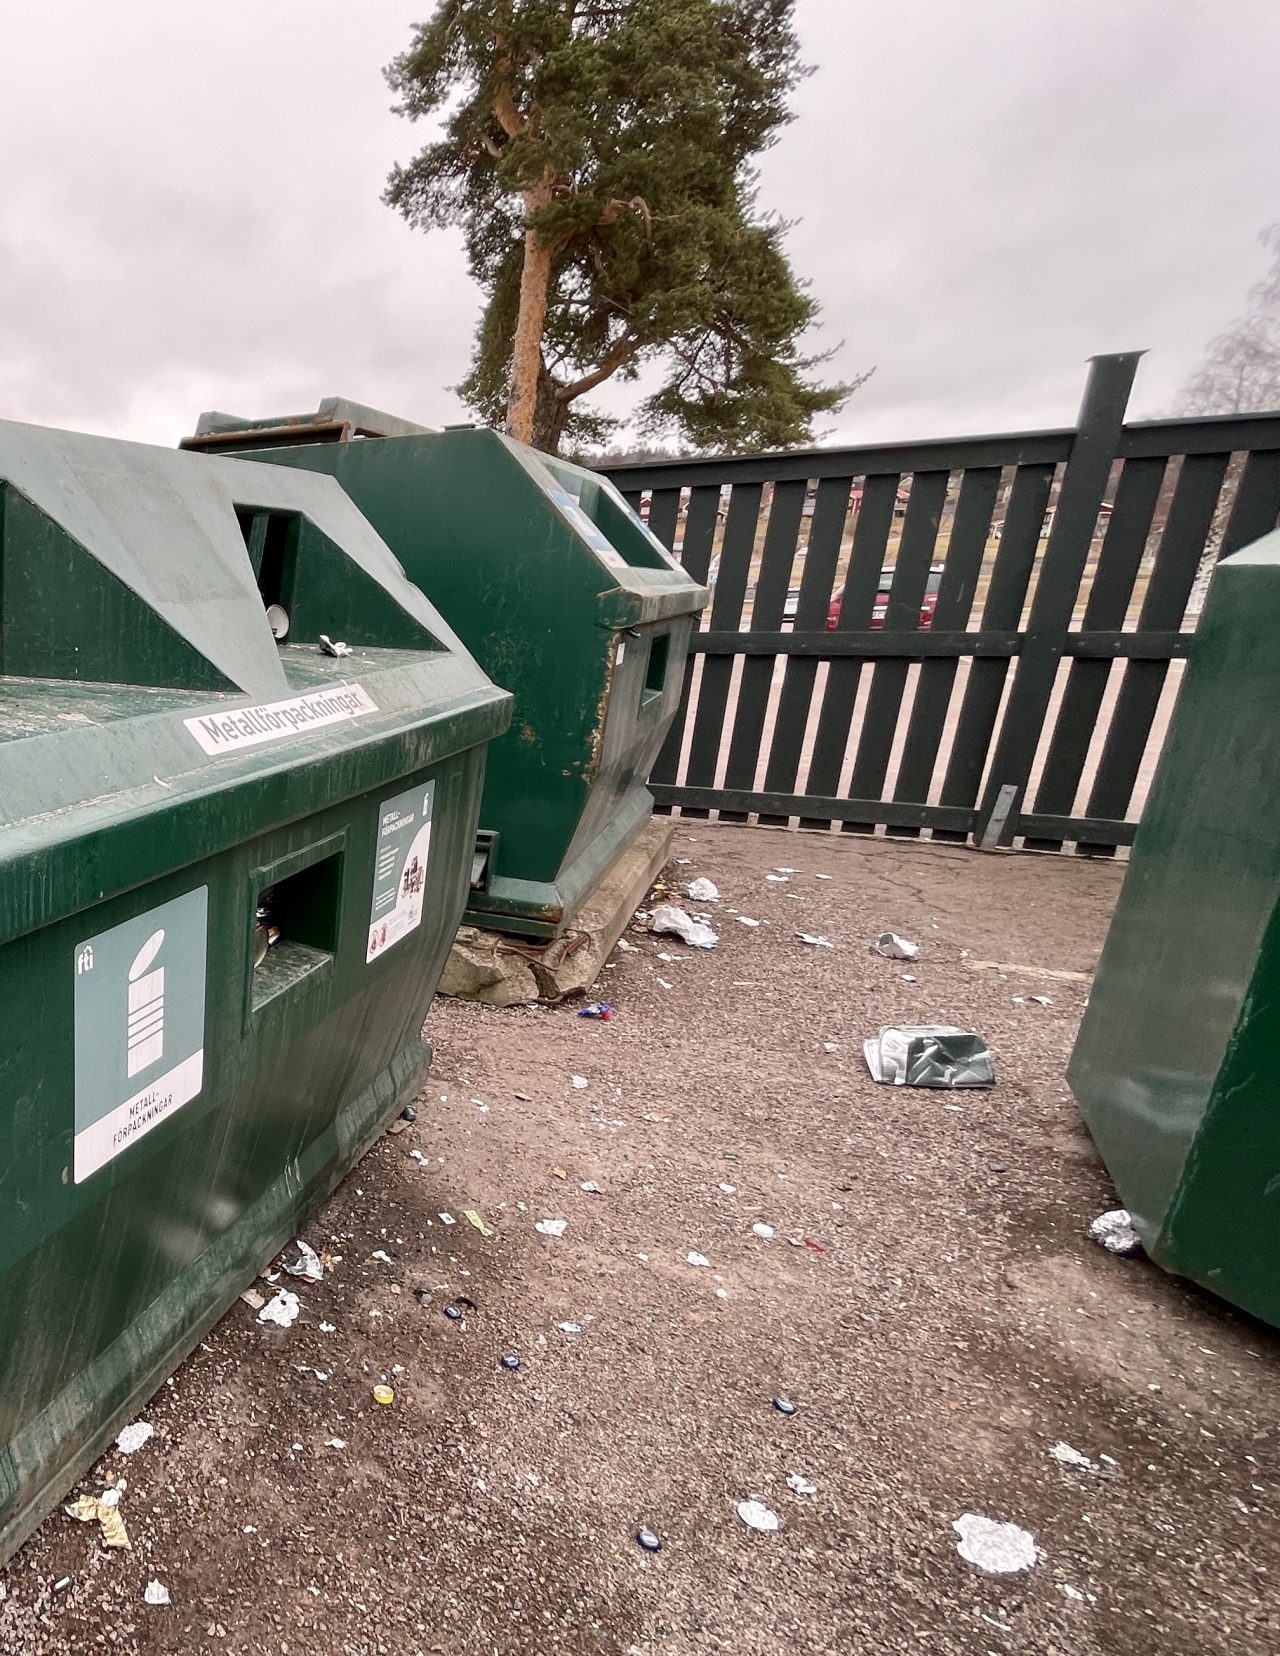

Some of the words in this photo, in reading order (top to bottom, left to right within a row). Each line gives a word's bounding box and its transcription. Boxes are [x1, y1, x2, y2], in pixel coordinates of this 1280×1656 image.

[198, 690, 362, 744] Metallförpackningar
[78, 945, 94, 975] fti
[112, 1094, 173, 1147] FÖRPACKNINGAR
[129, 1092, 160, 1119] METALL-
